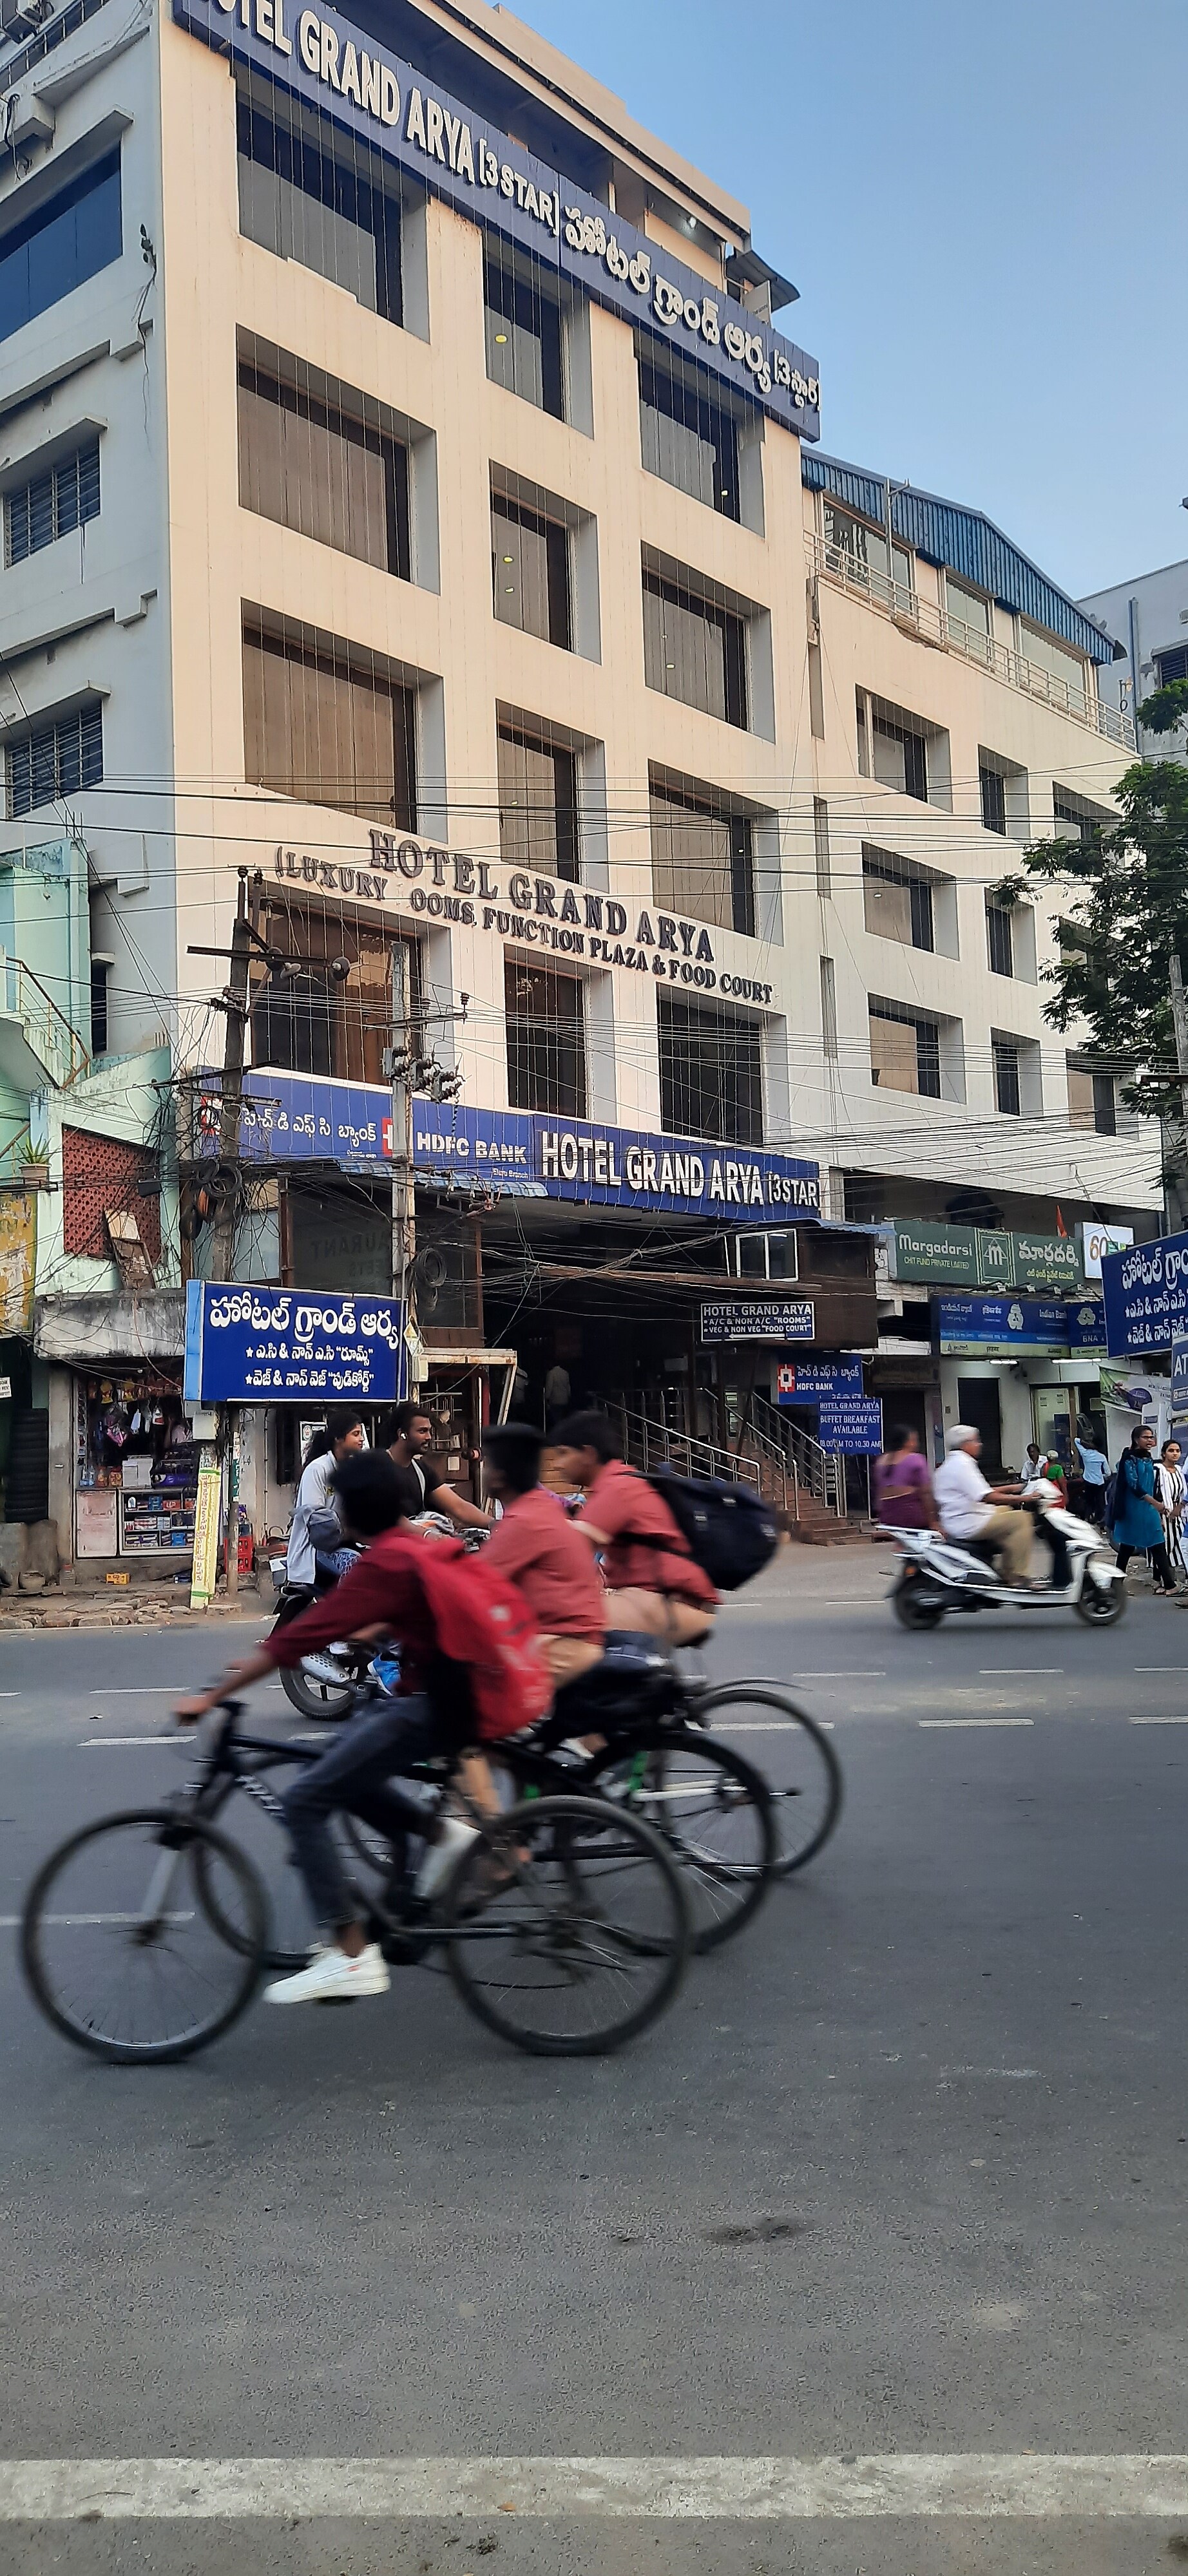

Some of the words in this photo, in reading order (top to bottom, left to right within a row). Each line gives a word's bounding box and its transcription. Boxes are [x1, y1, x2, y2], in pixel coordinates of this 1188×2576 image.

[300, 10, 400, 126] GRAND
[407, 87, 475, 184] ARYA
[564, 205, 651, 294] హోటల్
[653, 273, 720, 345] గ్రాండ్
[369, 828, 499, 900] HOTEL
[510, 873, 628, 936] GRAND
[636, 910, 714, 962] ARYA
[483, 906, 584, 954] FUNCTION
[589, 937, 649, 972] PLAZA
[652, 954, 666, 975] &
[669, 958, 716, 988] FOOD
[720, 972, 772, 1004] COURT
[416, 1132, 470, 1157] HDFC
[475, 1140, 527, 1164] BANK
[542, 1131, 622, 1186] HOTEL
[627, 1146, 704, 1197] GRAND
[710, 1161, 764, 1205] ARYA
[899, 1234, 973, 1257] Margadarsi
[1122, 1247, 1163, 1290] హోటల్
[704, 1306, 738, 1316] HOTEL
[741, 1305, 780, 1316] GRAND
[783, 1305, 812, 1315] ARYA
[1145, 1296, 1153, 1314] &
[210, 1291, 292, 1331] హోటల్
[294, 1302, 356, 1343] గ్రాండ్
[361, 1310, 399, 1350] ఆర్య
[1145, 1323, 1153, 1342] &
[279, 1343, 289, 1359] &
[292, 1343, 313, 1360] నాన్
[253, 1368, 272, 1386] వెజ్
[273, 1370, 283, 1386] &
[286, 1369, 308, 1386] నాన్
[310, 1370, 327, 1387] వెజ్
[820, 1415, 842, 1424] BUFFET
[843, 1415, 881, 1424] BREAKFAST
[832, 1425, 868, 1434] AVAILABLE
